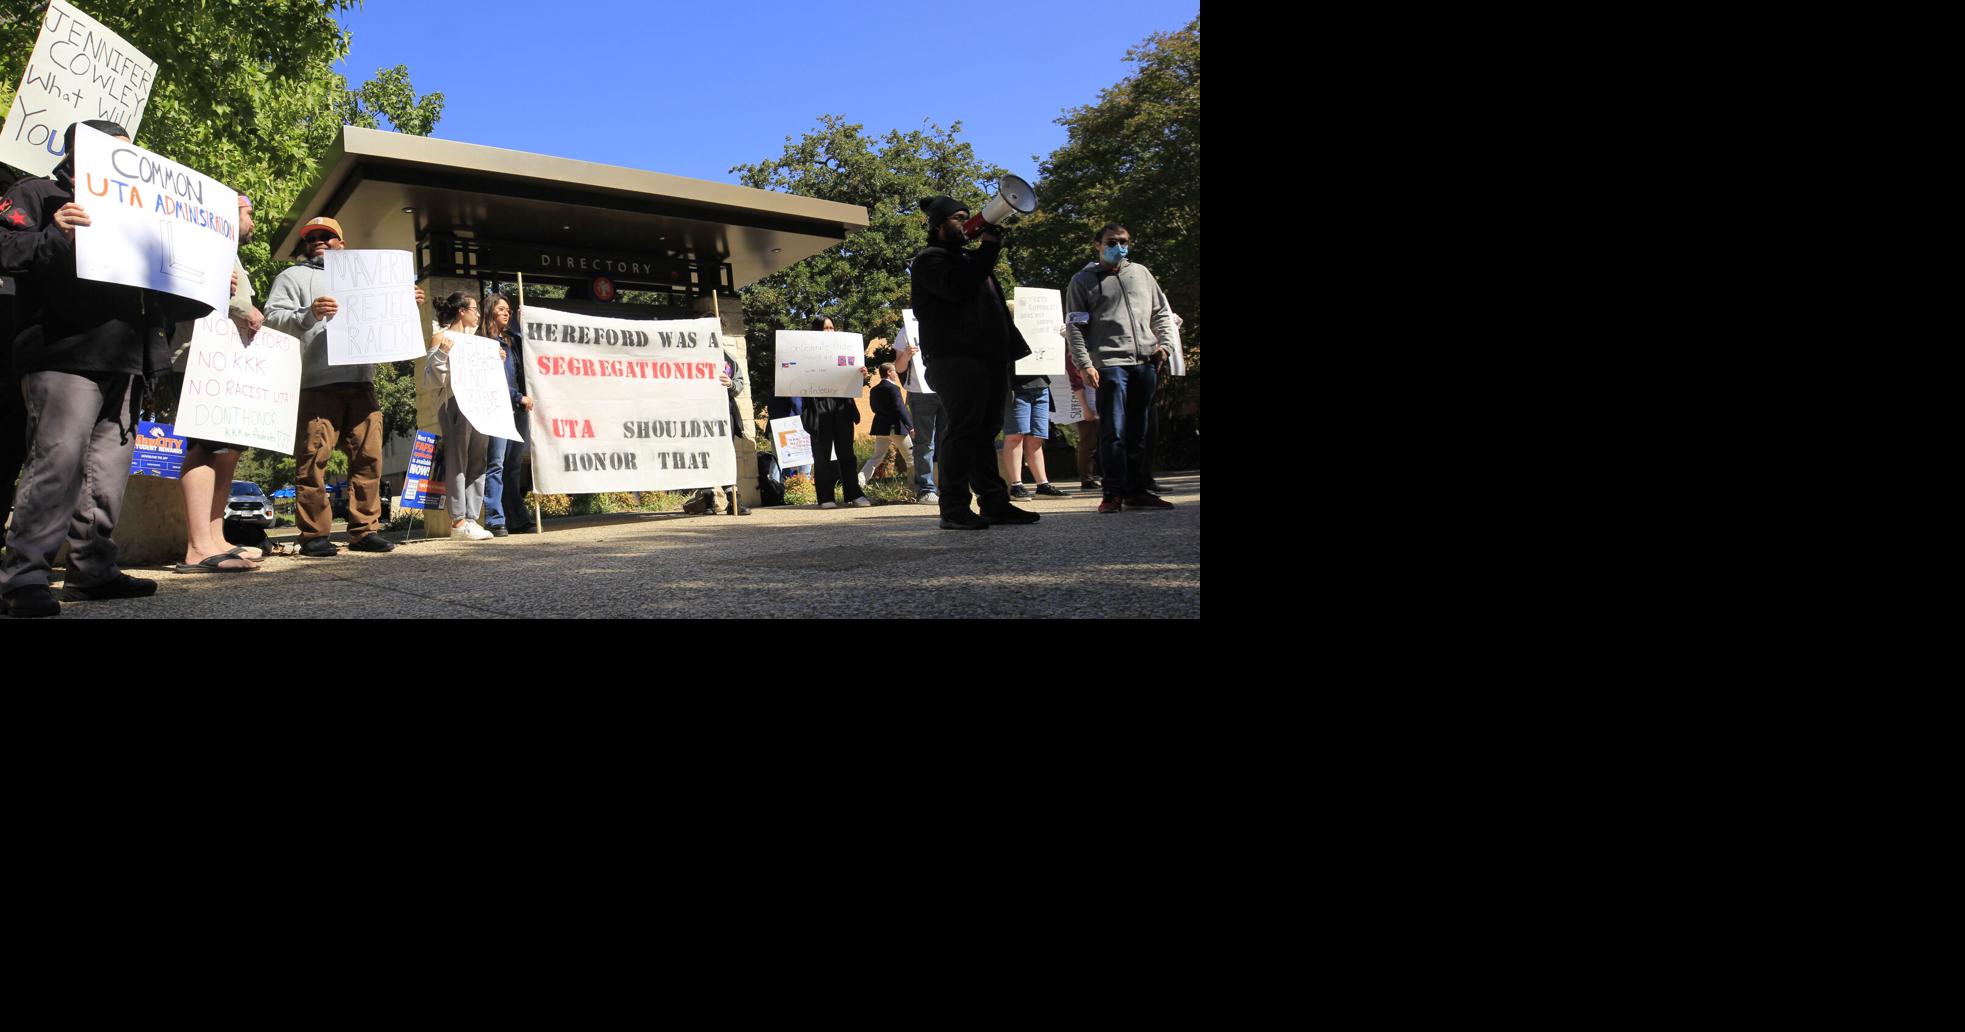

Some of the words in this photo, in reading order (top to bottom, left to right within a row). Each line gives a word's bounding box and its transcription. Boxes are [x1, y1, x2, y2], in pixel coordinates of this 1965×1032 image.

[45, 6, 152, 95] JENNIFER
[27, 64, 84, 109] What
[50, 41, 145, 117] COWLEY
[111, 148, 204, 205] COMMON
[86, 173, 143, 209] UTA
[541, 254, 652, 275] DIRECTORY
[202, 318, 229, 336] NO
[527, 322, 650, 348] HEREFORD
[658, 331, 697, 349] WAS
[708, 332, 720, 348] A
[198, 351, 227, 371] NO
[233, 352, 266, 375] KKK
[536, 355, 718, 380] SEGREGATIONIST
[188, 379, 221, 397] NO
[225, 380, 271, 402] RACIST
[551, 419, 596, 439] UTA
[623, 419, 729, 439] SHOULDNT
[409, 463, 431, 477] NOW!
[563, 451, 639, 472] HONOR
[657, 451, 711, 470] THAT
